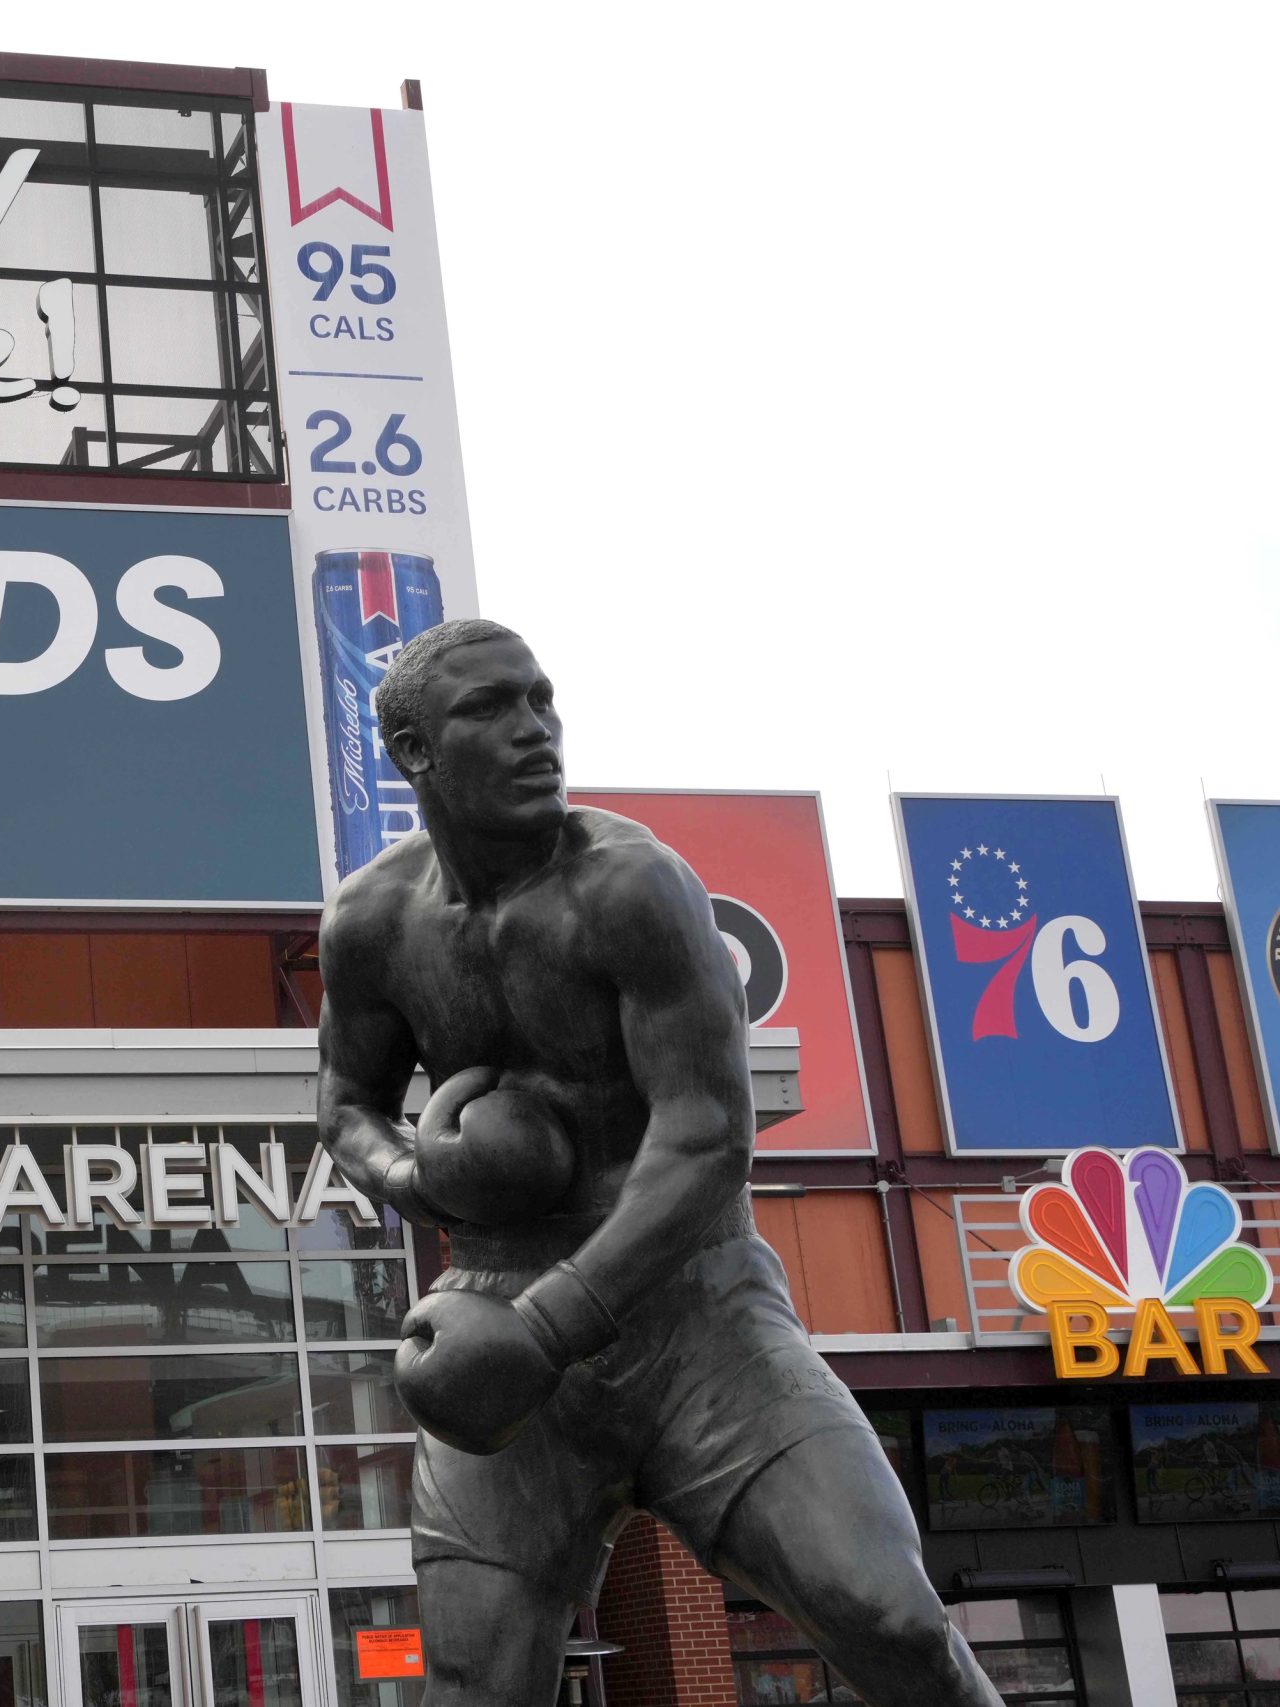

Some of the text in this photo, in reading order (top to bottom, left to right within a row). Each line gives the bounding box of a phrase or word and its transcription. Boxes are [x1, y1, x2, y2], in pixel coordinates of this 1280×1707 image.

[296, 241, 396, 305] 95
[309, 314, 394, 342] CALS
[305, 409, 423, 477] 2.6
[312, 485, 427, 515] CARBS
[406, 585, 415, 594] 95
[336, 673, 370, 812] Michelob
[949, 911, 1121, 1043] 76
[1046, 1296, 1270, 1379] BAR
[938, 1419, 979, 1433] BRING
[991, 1418, 1035, 1432] ALOHA
[1197, 1412, 1240, 1426] ALOHA
